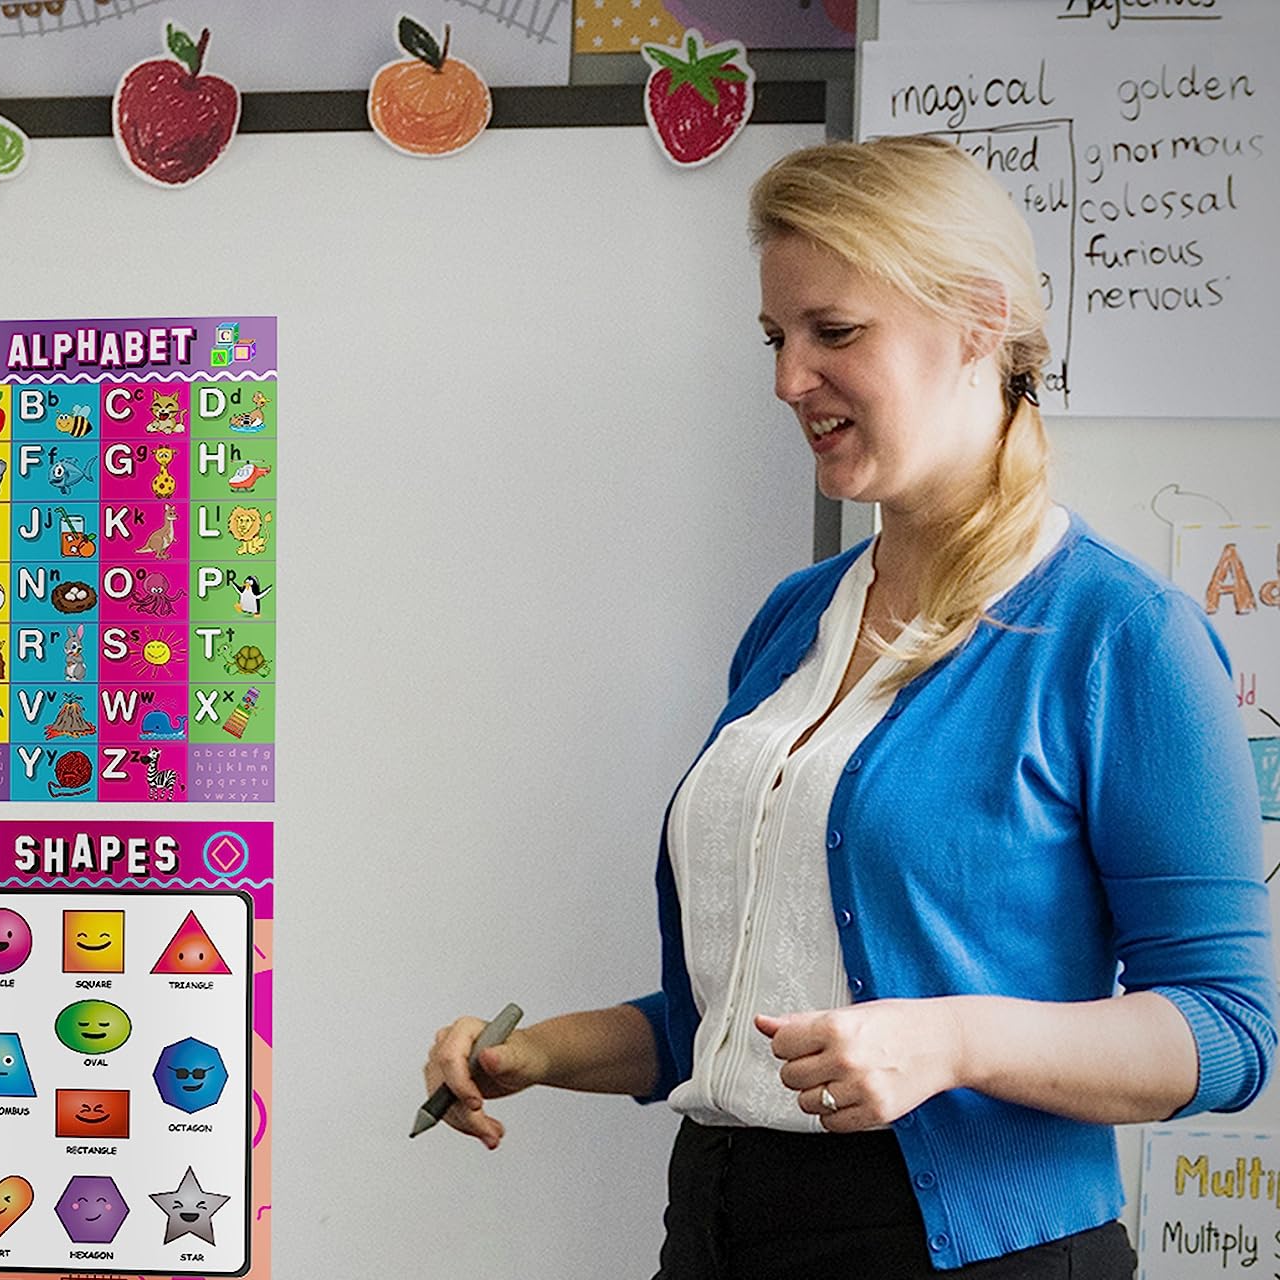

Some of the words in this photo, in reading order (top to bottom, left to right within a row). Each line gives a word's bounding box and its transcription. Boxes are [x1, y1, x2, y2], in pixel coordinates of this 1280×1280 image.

[892, 59, 1055, 128] magical
[1118, 65, 1255, 121] golden
[1080, 176, 1238, 224] colossal
[1085, 234, 1203, 268] furious
[1087, 281, 1224, 313] nervous
[7, 327, 195, 371] ALPHABET
[14, 833, 180, 876] SHAPES
[75, 980, 113, 990] SQUARE
[169, 981, 214, 990] TRIANGLE
[83, 1058, 108, 1067] OVAL
[167, 1124, 213, 1133] OCTAGON
[66, 1146, 117, 1156] RECTANGLE
[1175, 1154, 1280, 1209] Multi
[69, 1251, 114, 1261] HEXAGON
[180, 1253, 204, 1262] STAR
[1162, 1220, 1258, 1268] Multiply
